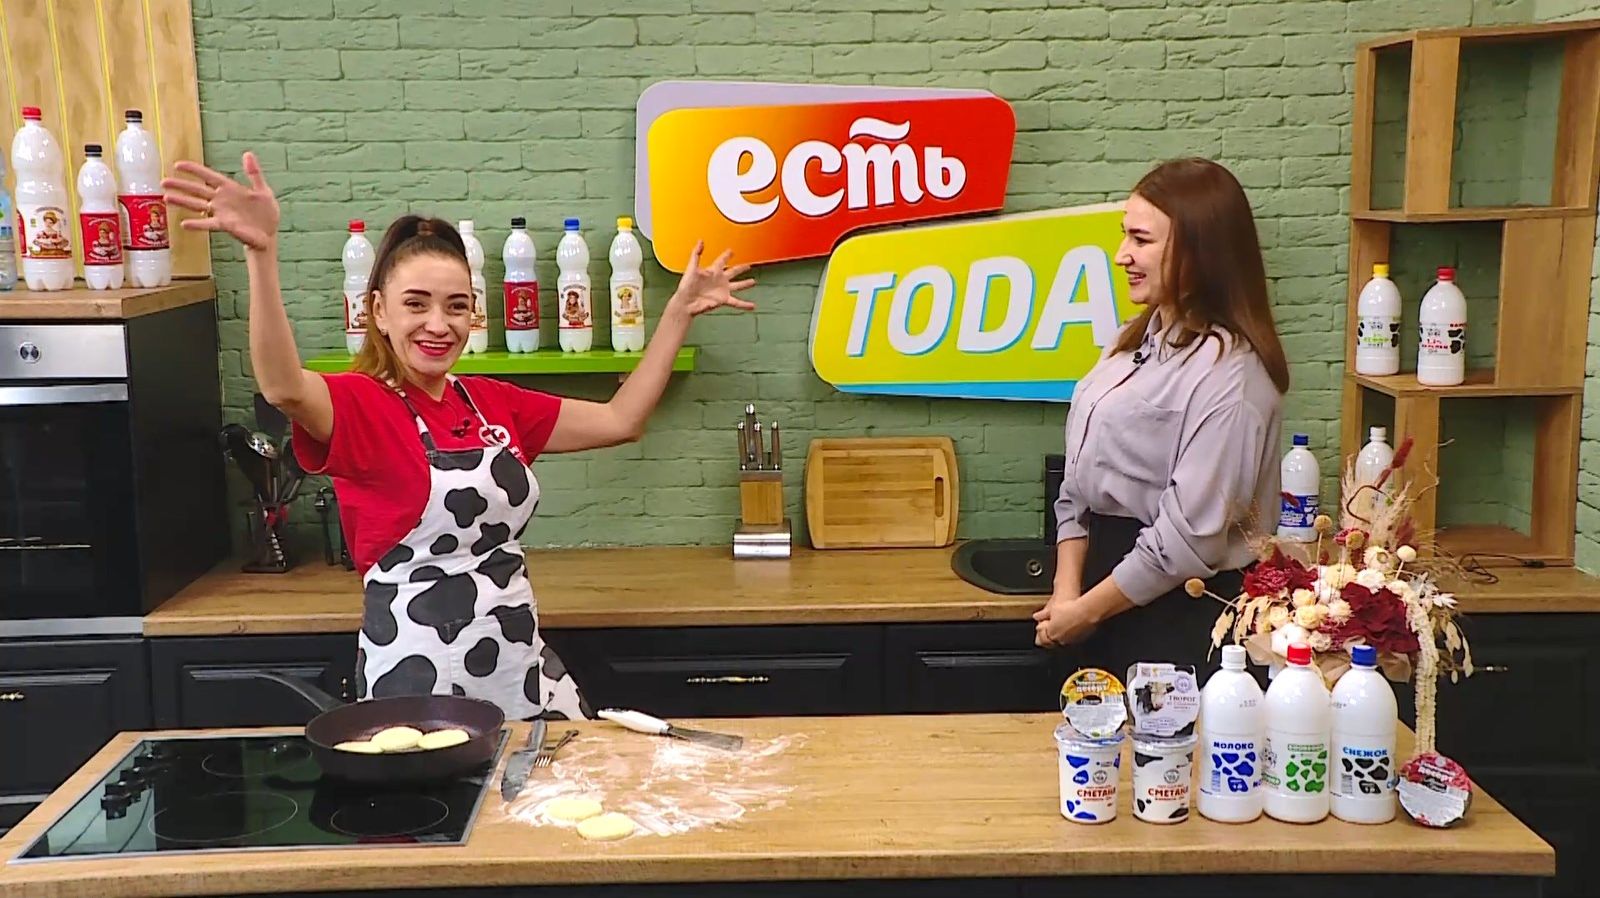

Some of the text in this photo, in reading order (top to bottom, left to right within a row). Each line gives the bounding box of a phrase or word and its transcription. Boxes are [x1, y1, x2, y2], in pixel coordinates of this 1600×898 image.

[707, 117, 966, 223] есть
[844, 245, 1120, 357] TODA
[1213, 741, 1255, 751] МОЛОКО
[1342, 746, 1388, 758] СНЕЖОК
[1076, 786, 1116, 798] СМЕТАНА
[1147, 785, 1189, 798] СМЕТАНА
